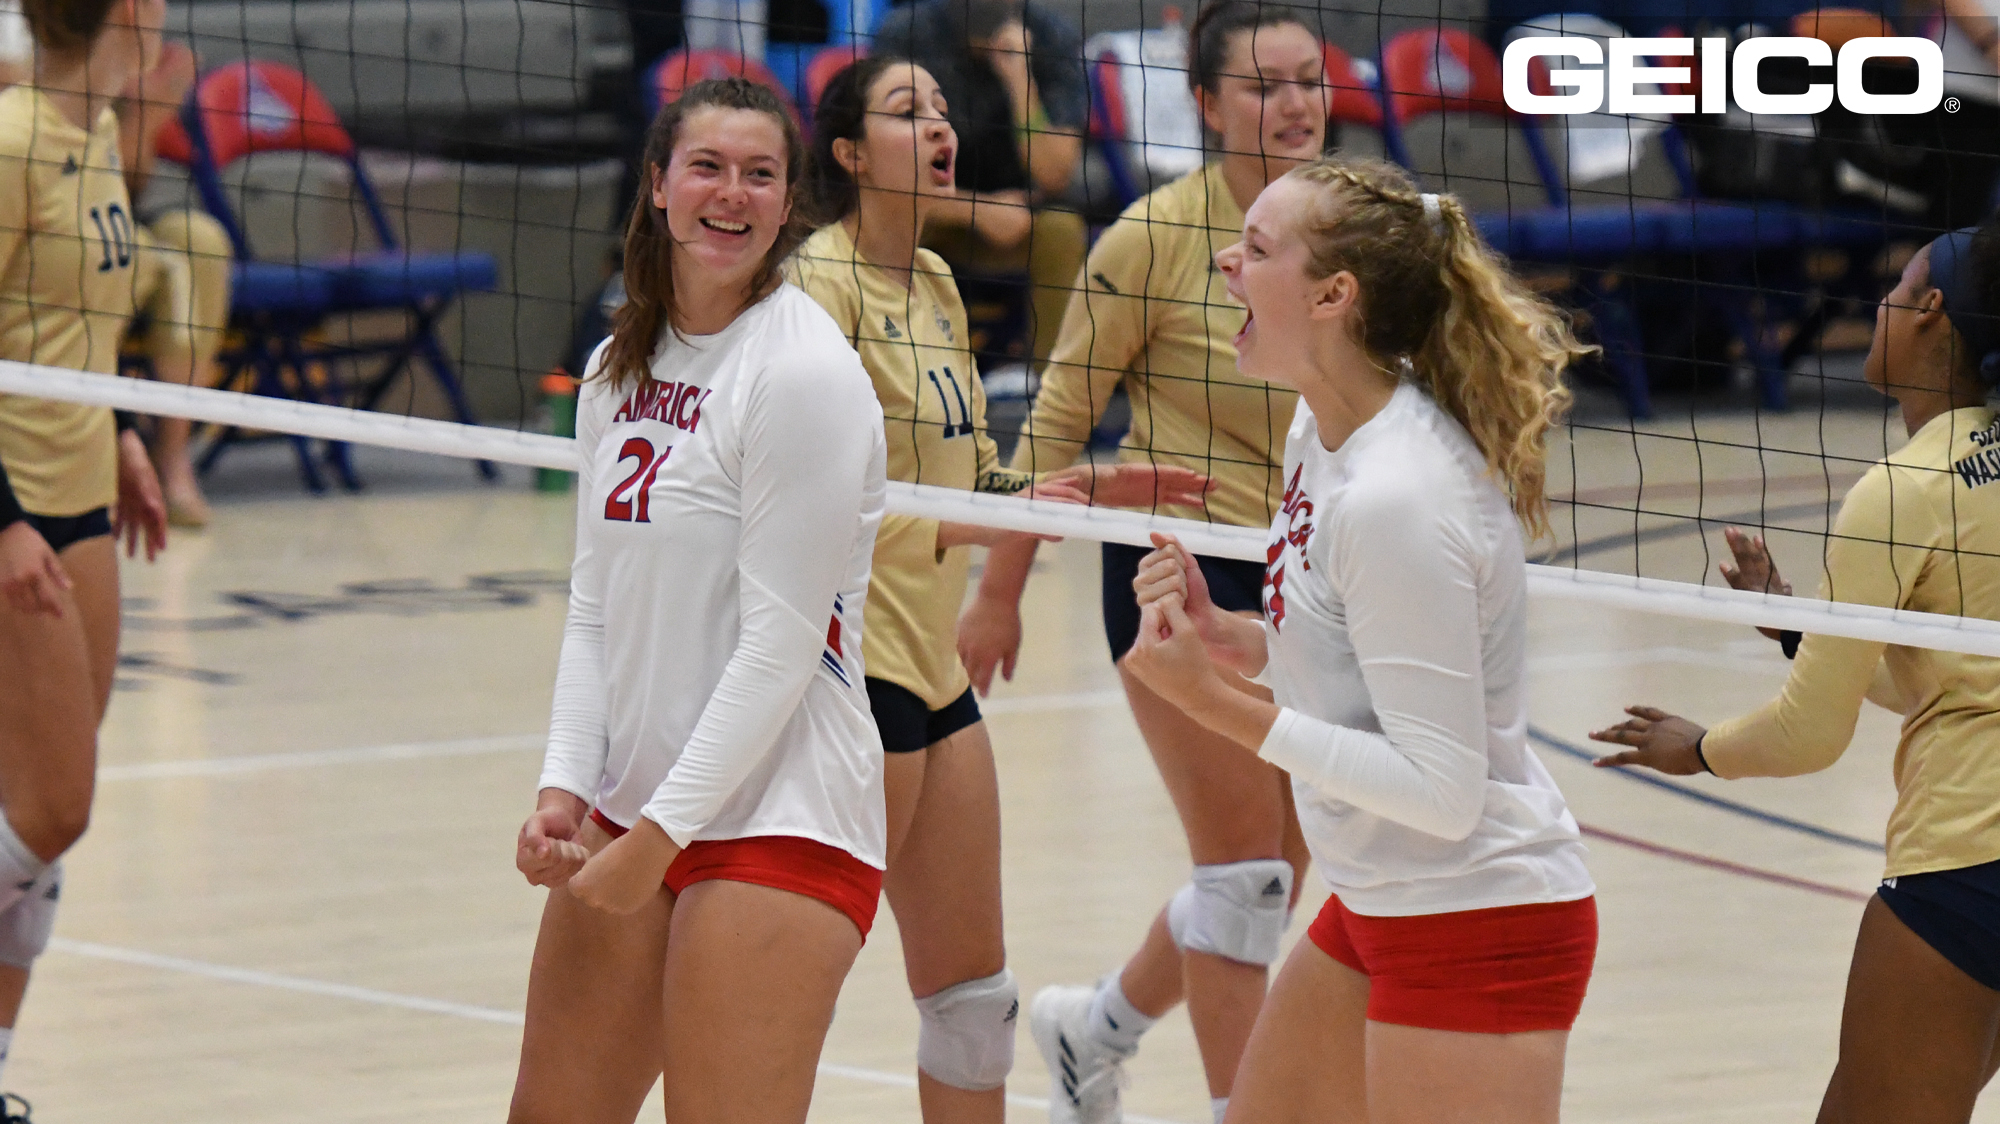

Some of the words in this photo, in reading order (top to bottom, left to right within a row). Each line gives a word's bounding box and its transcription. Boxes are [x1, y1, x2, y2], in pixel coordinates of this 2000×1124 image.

[91, 203, 131, 272] 10
[928, 366, 974, 439] 11
[604, 437, 673, 523] 21
[1955, 447, 2000, 489] WAS
